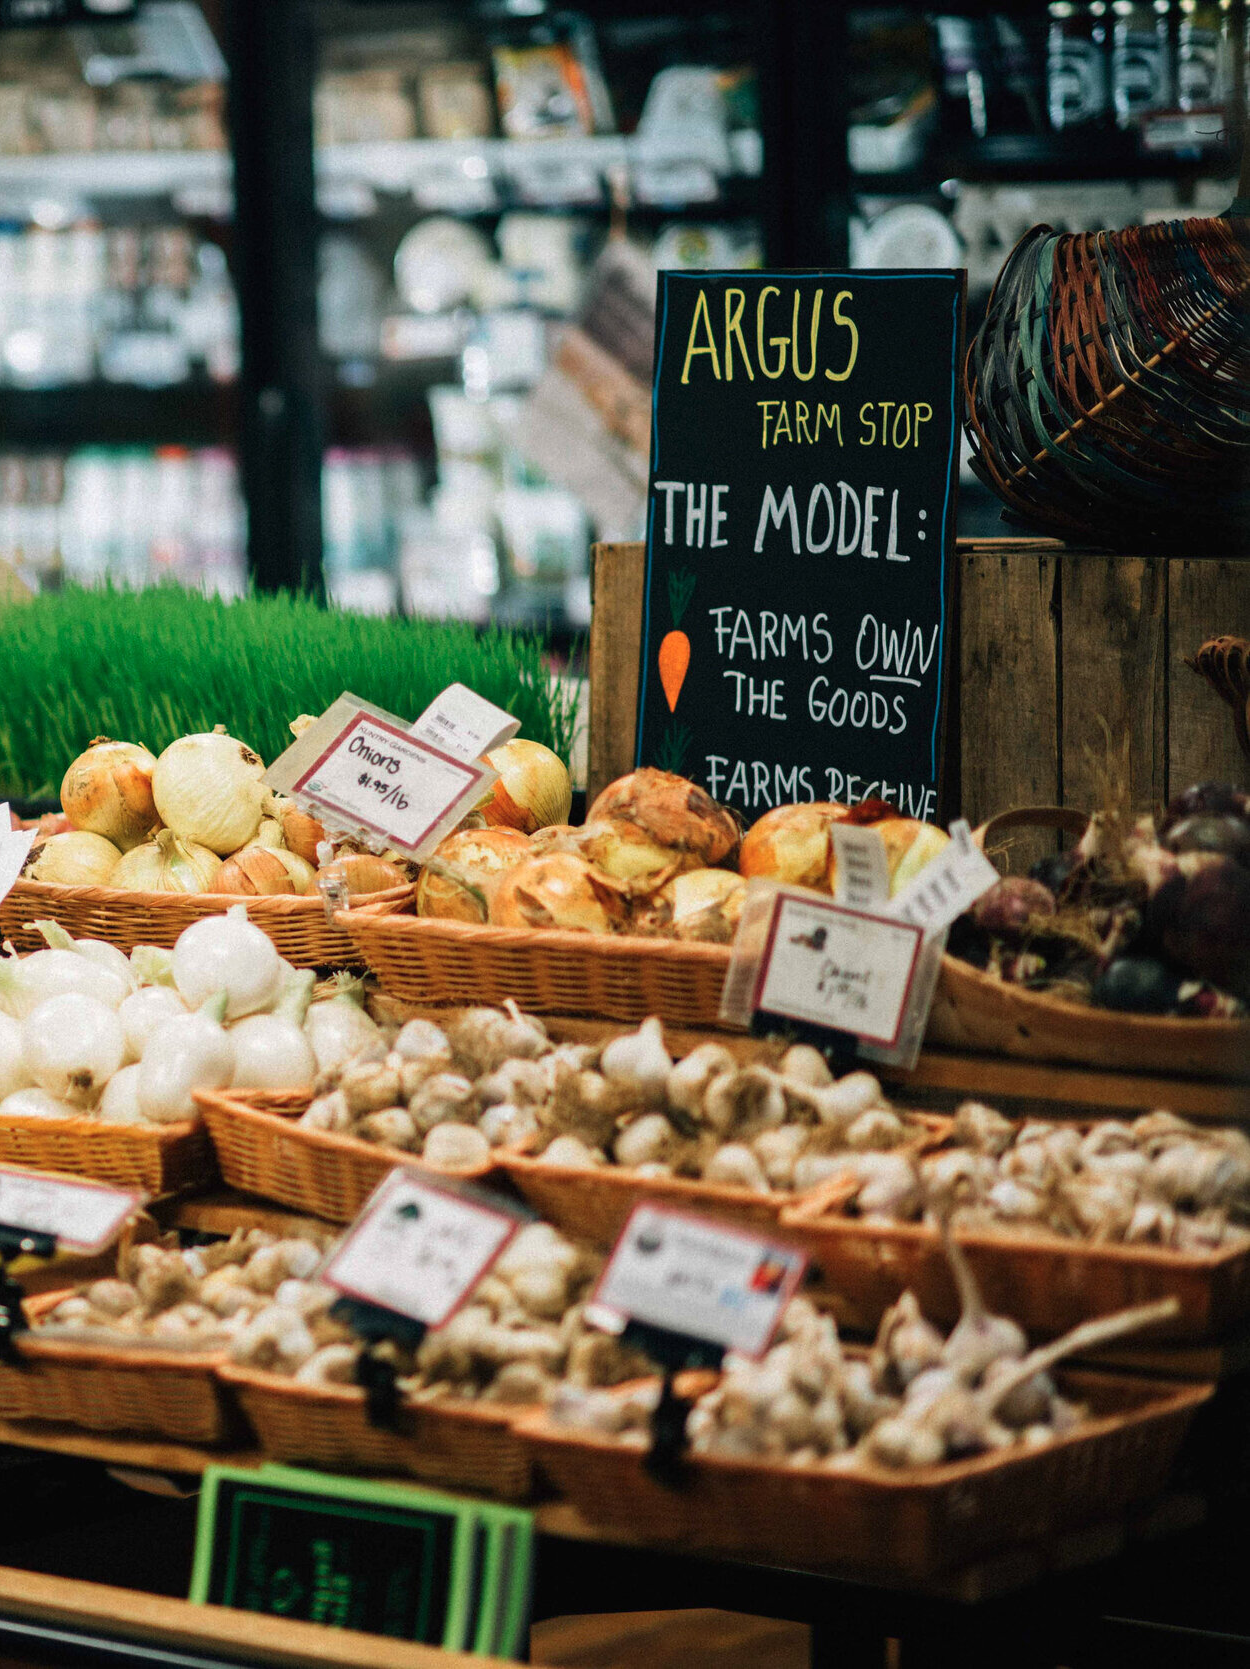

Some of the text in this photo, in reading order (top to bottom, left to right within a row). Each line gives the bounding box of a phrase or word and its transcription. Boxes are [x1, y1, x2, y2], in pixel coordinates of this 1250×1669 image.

[681, 286, 859, 384] ARGUS
[757, 400, 933, 449] FARM STOP
[654, 481, 927, 562] THE MODEL:
[709, 607, 939, 676] FARMS OWN
[723, 671, 908, 735] THE GOODS
[348, 736, 401, 775] Onions
[706, 755, 815, 808] FARMS
[357, 772, 409, 811] $1.95/lb
